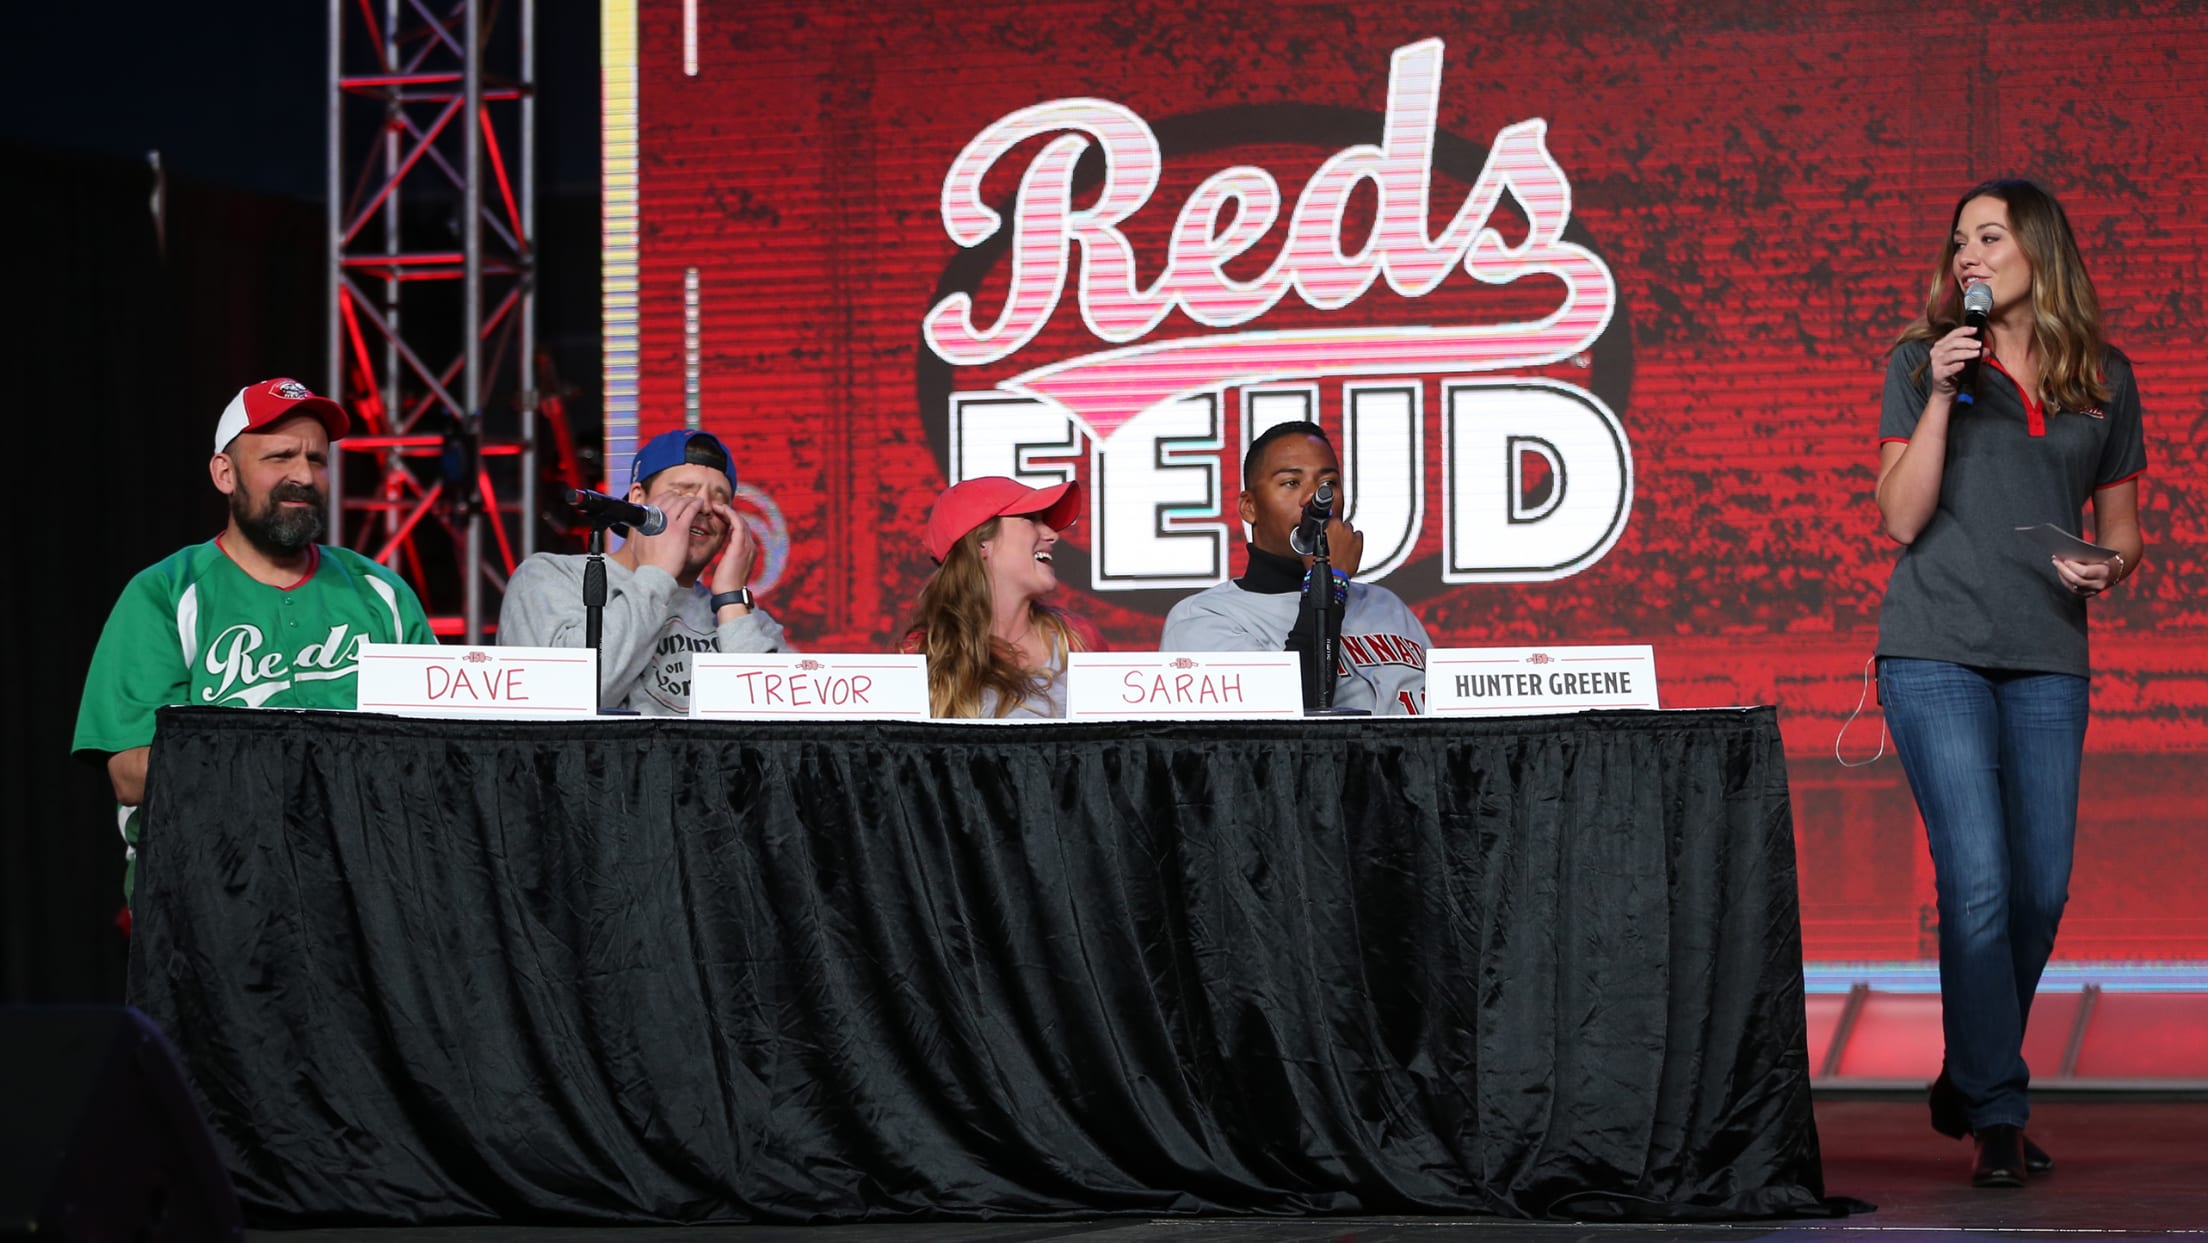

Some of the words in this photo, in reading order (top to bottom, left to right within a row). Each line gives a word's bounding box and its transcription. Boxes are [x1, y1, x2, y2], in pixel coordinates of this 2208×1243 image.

[923, 37, 1616, 368] Reds
[948, 377, 1634, 591] FEUD
[202, 623, 371, 702] Reds
[665, 661, 684, 674] on
[426, 665, 529, 700] DAVE
[736, 671, 872, 706] TREVOR
[1122, 670, 1243, 704] SARAH
[1455, 673, 1543, 698] HUNTER
[1549, 671, 1632, 695] GREENE
